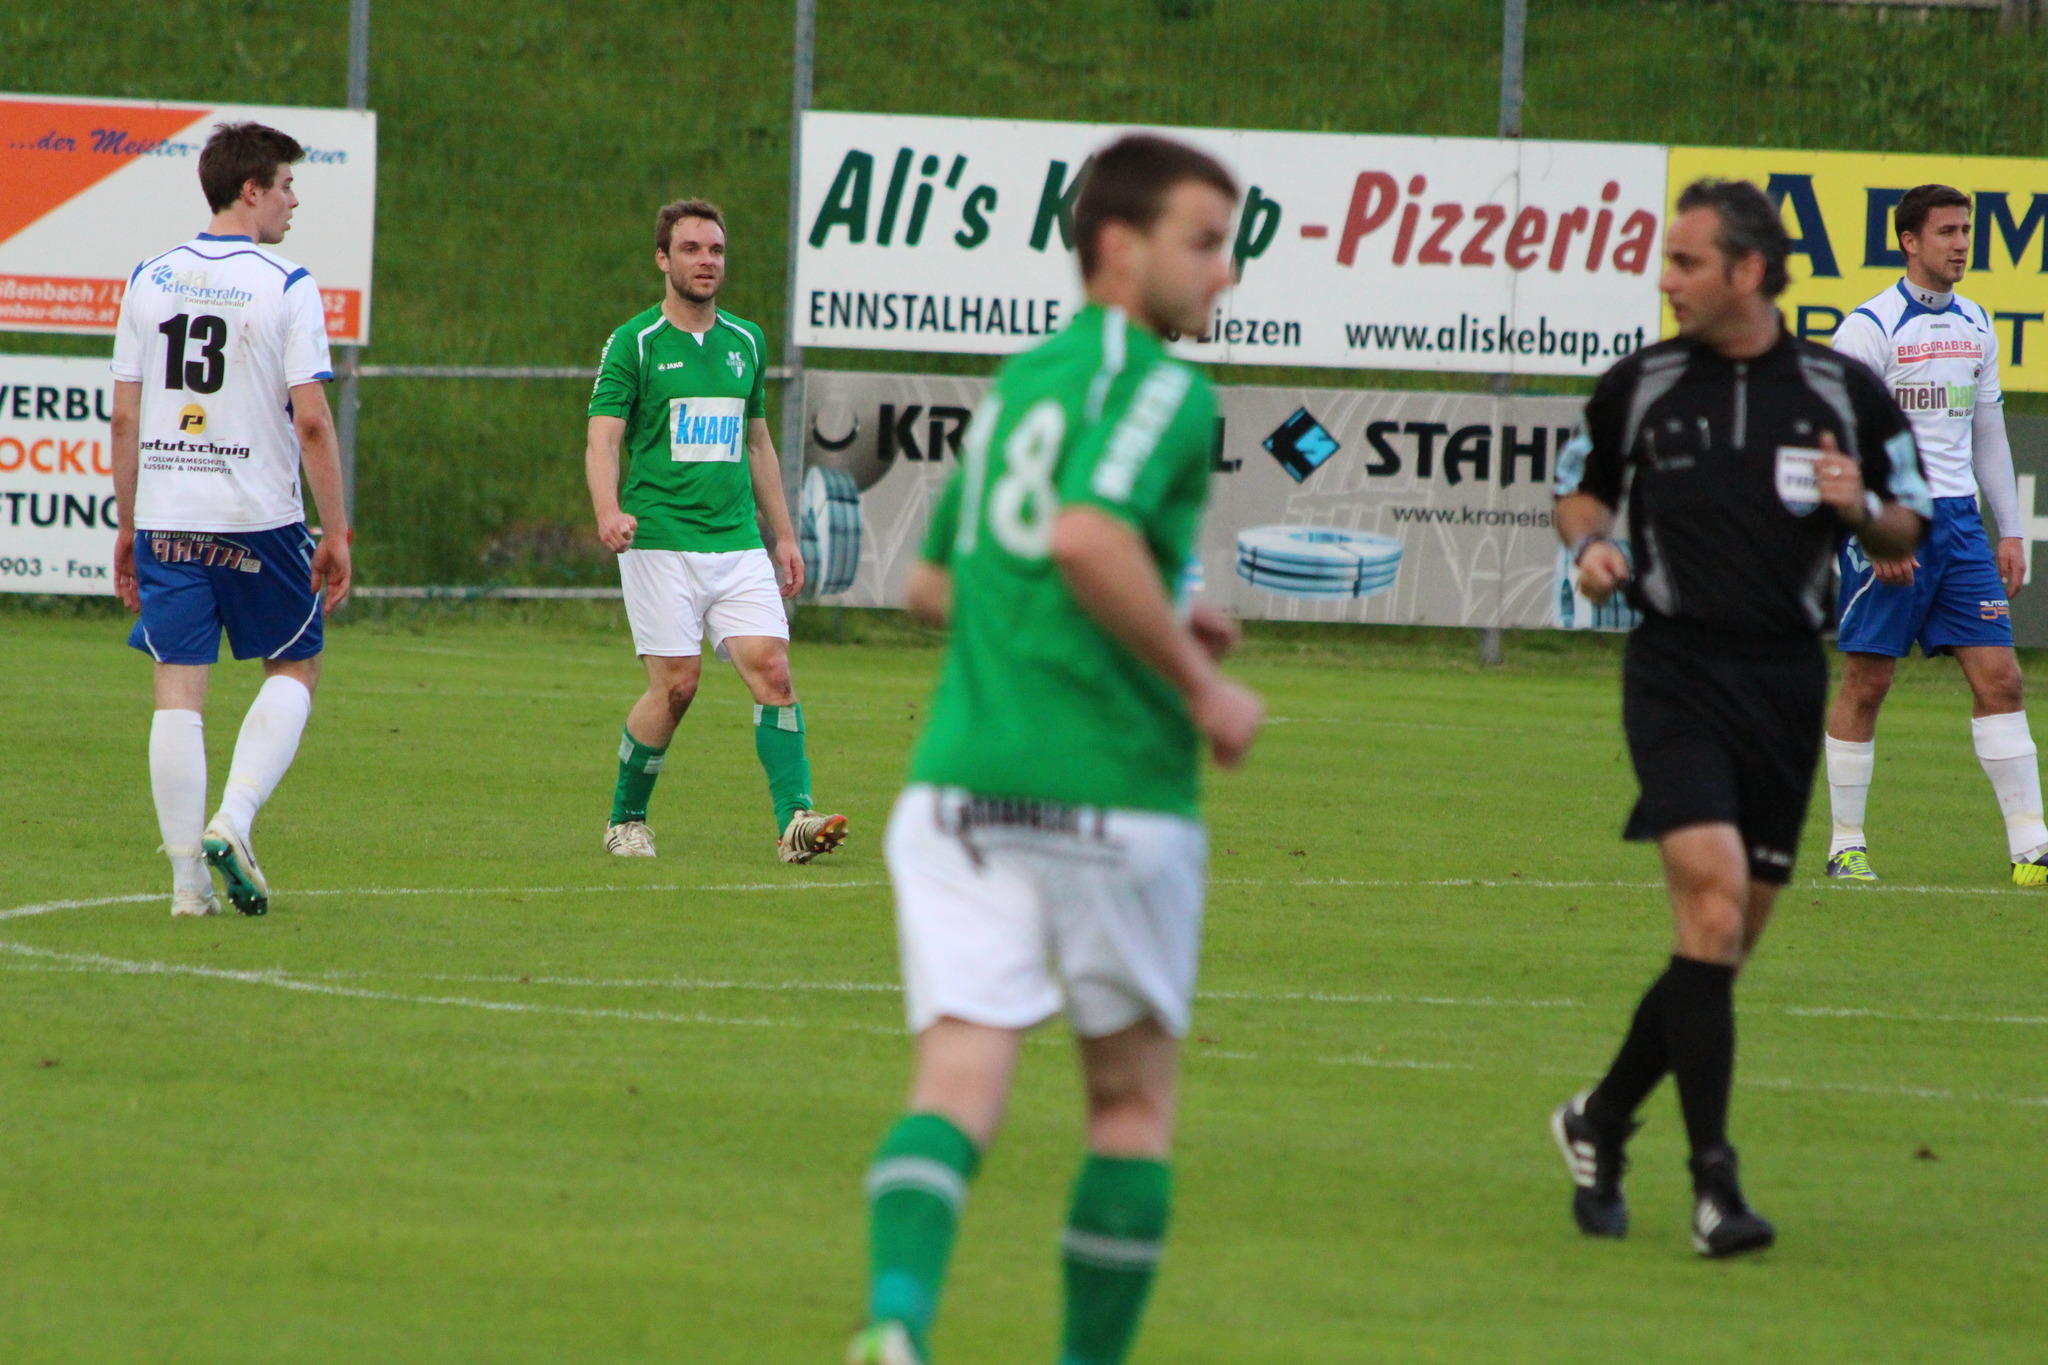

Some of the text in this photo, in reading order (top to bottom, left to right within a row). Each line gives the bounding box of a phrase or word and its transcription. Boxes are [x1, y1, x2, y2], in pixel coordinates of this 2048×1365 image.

[808, 147, 998, 250] Ali's
[810, 289, 1060, 336] ENNSTALHALLE
[159, 313, 228, 394] 13
[1345, 313, 1646, 366] www.aliskebap.at
[666, 361, 684, 370] JAKO
[0, 386, 111, 421] ERBU
[954, 394, 1067, 561] 18
[67, 559, 108, 578] Fax
